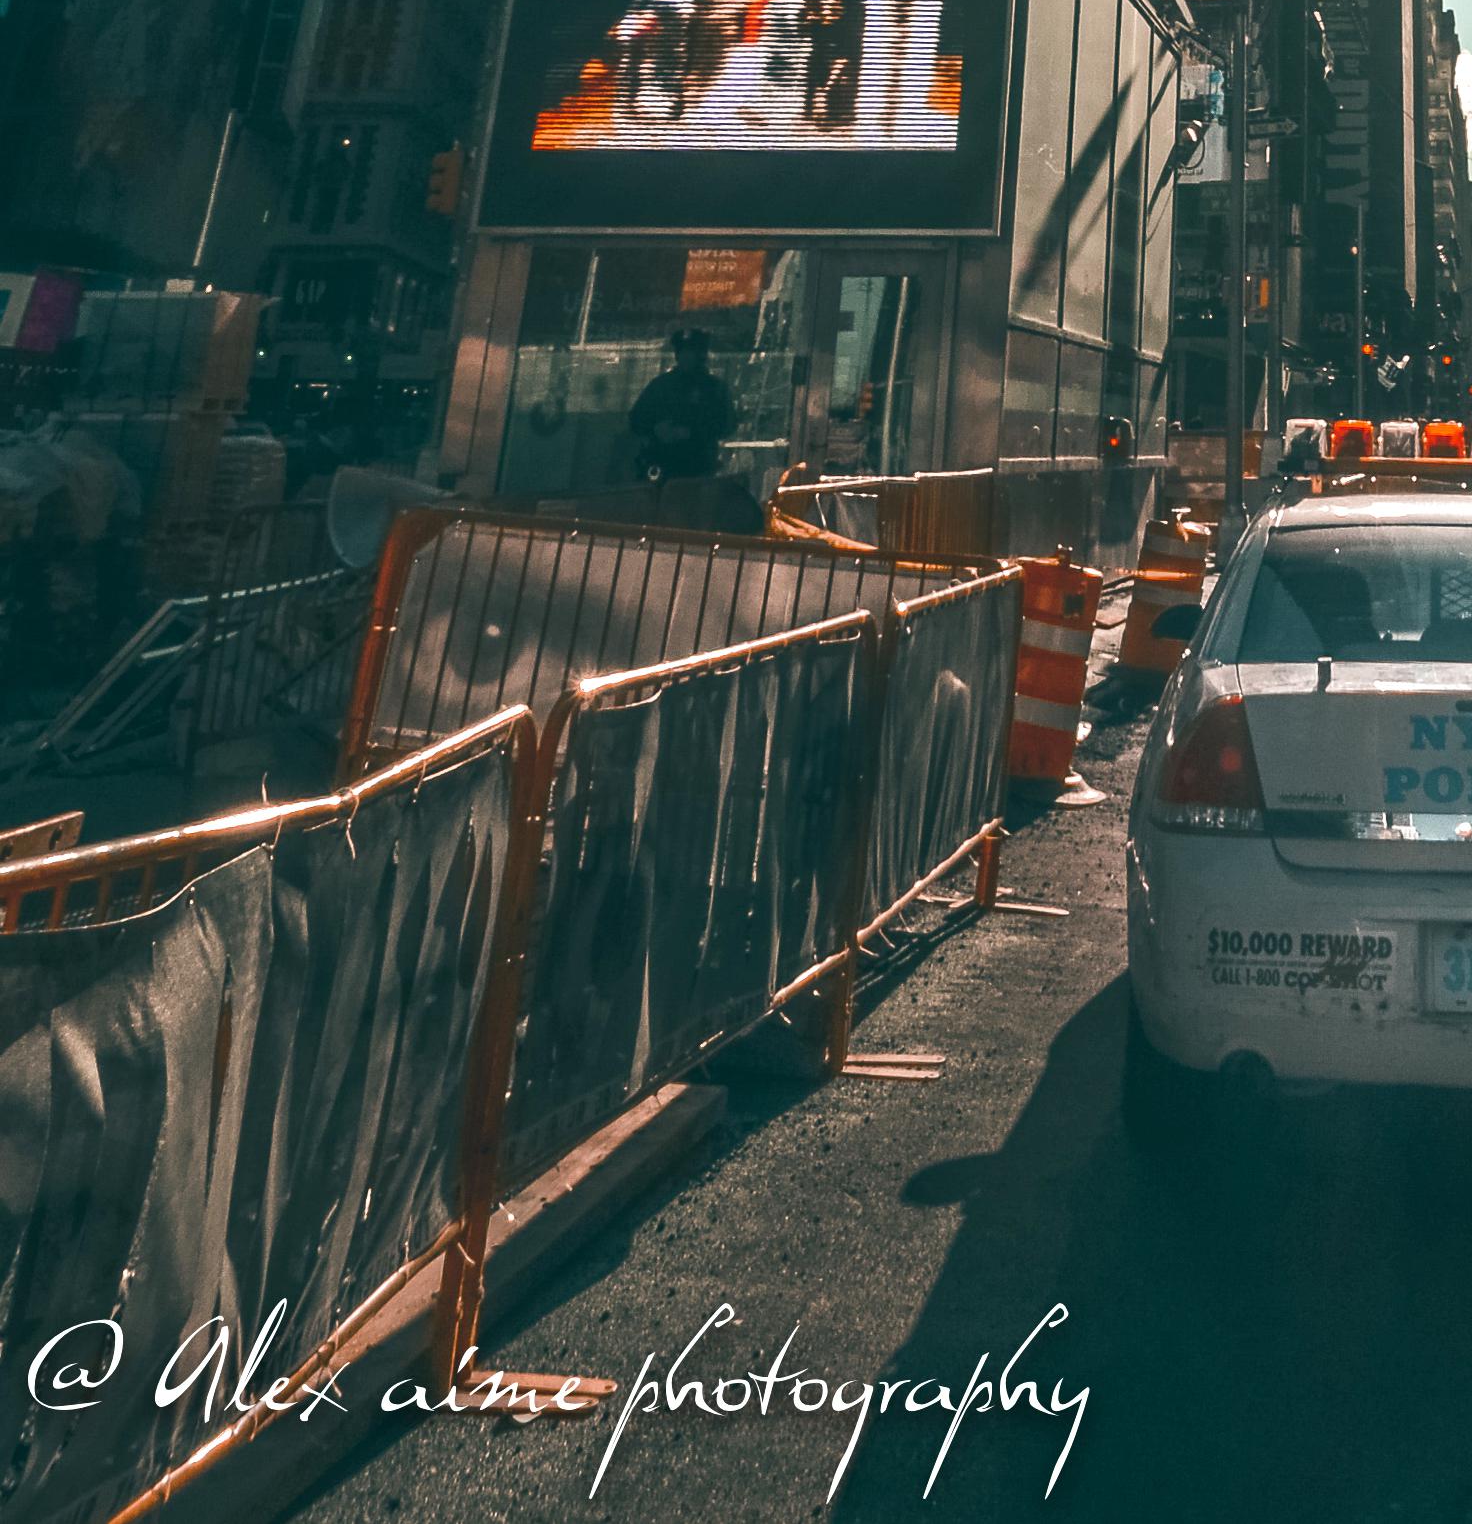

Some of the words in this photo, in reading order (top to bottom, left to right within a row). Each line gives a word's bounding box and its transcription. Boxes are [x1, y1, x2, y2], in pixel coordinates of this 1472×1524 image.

[1208, 927, 1293, 957] $10,000
[1300, 932, 1393, 959] REWARD
[1211, 967, 1242, 986] CALL
[1245, 968, 1281, 987] 1-800
